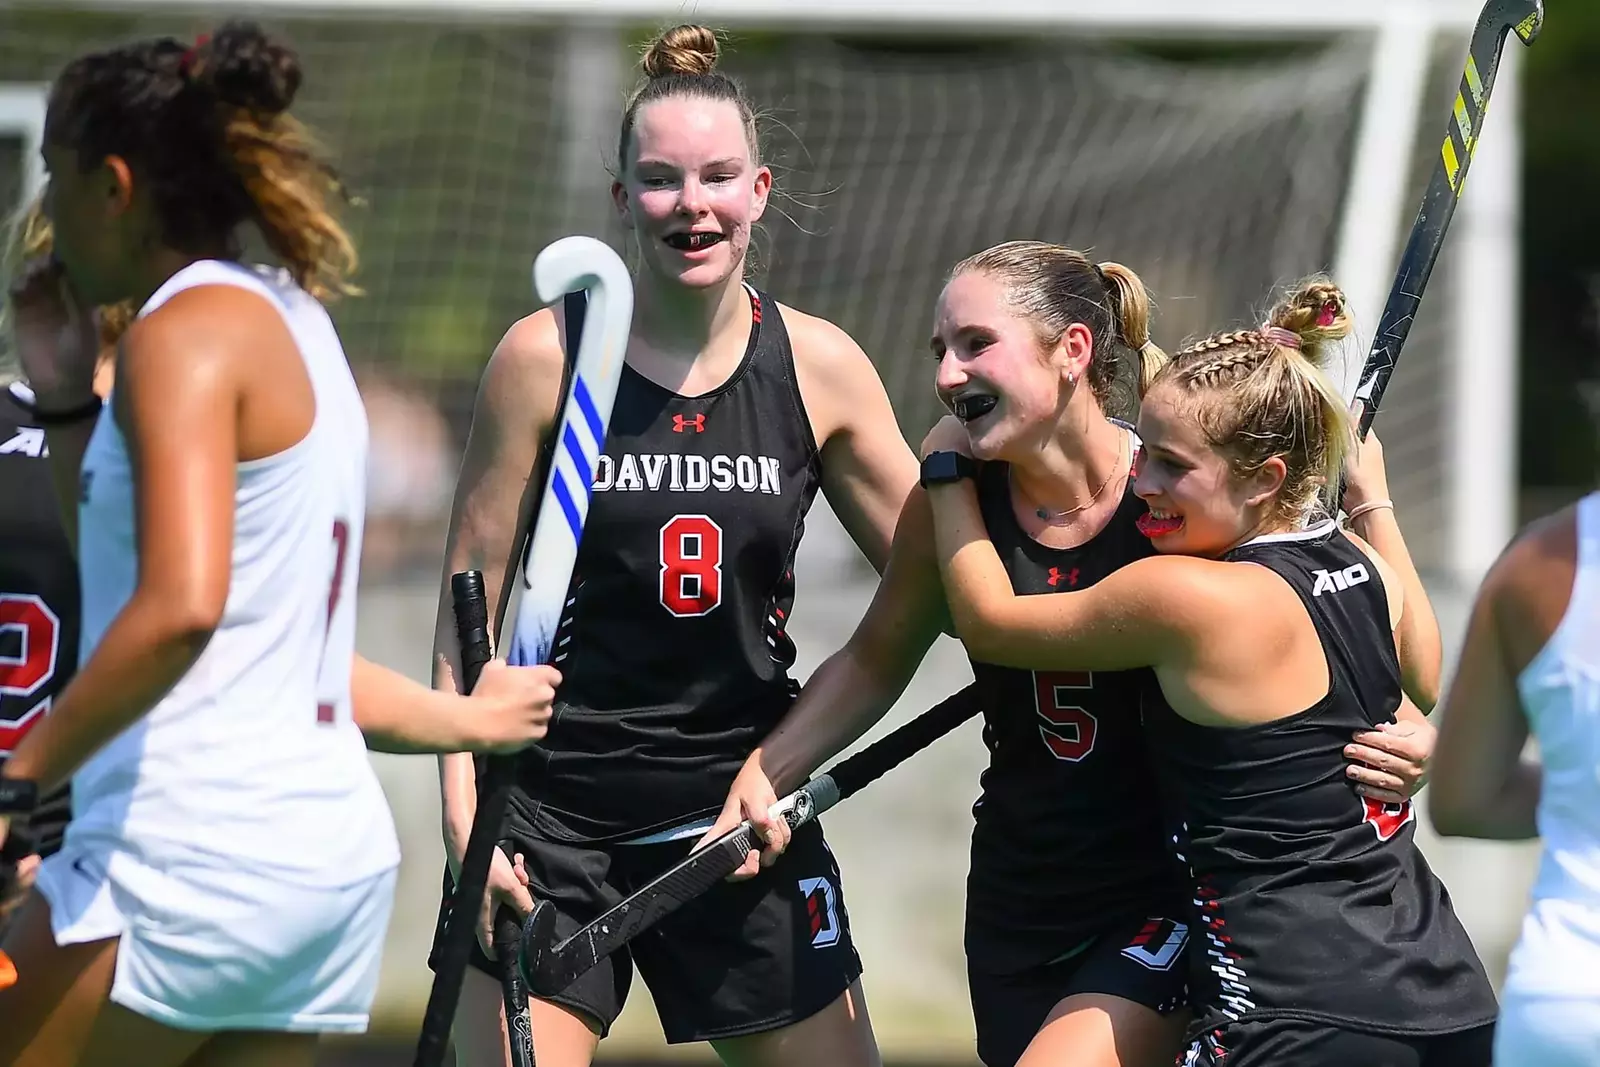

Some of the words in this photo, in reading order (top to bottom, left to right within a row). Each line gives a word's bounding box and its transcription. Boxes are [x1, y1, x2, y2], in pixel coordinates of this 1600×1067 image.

[591, 454, 781, 495] DAVIDSON
[659, 514, 723, 618] 8
[1311, 562, 1370, 597] A10
[1031, 669, 1098, 762] 5
